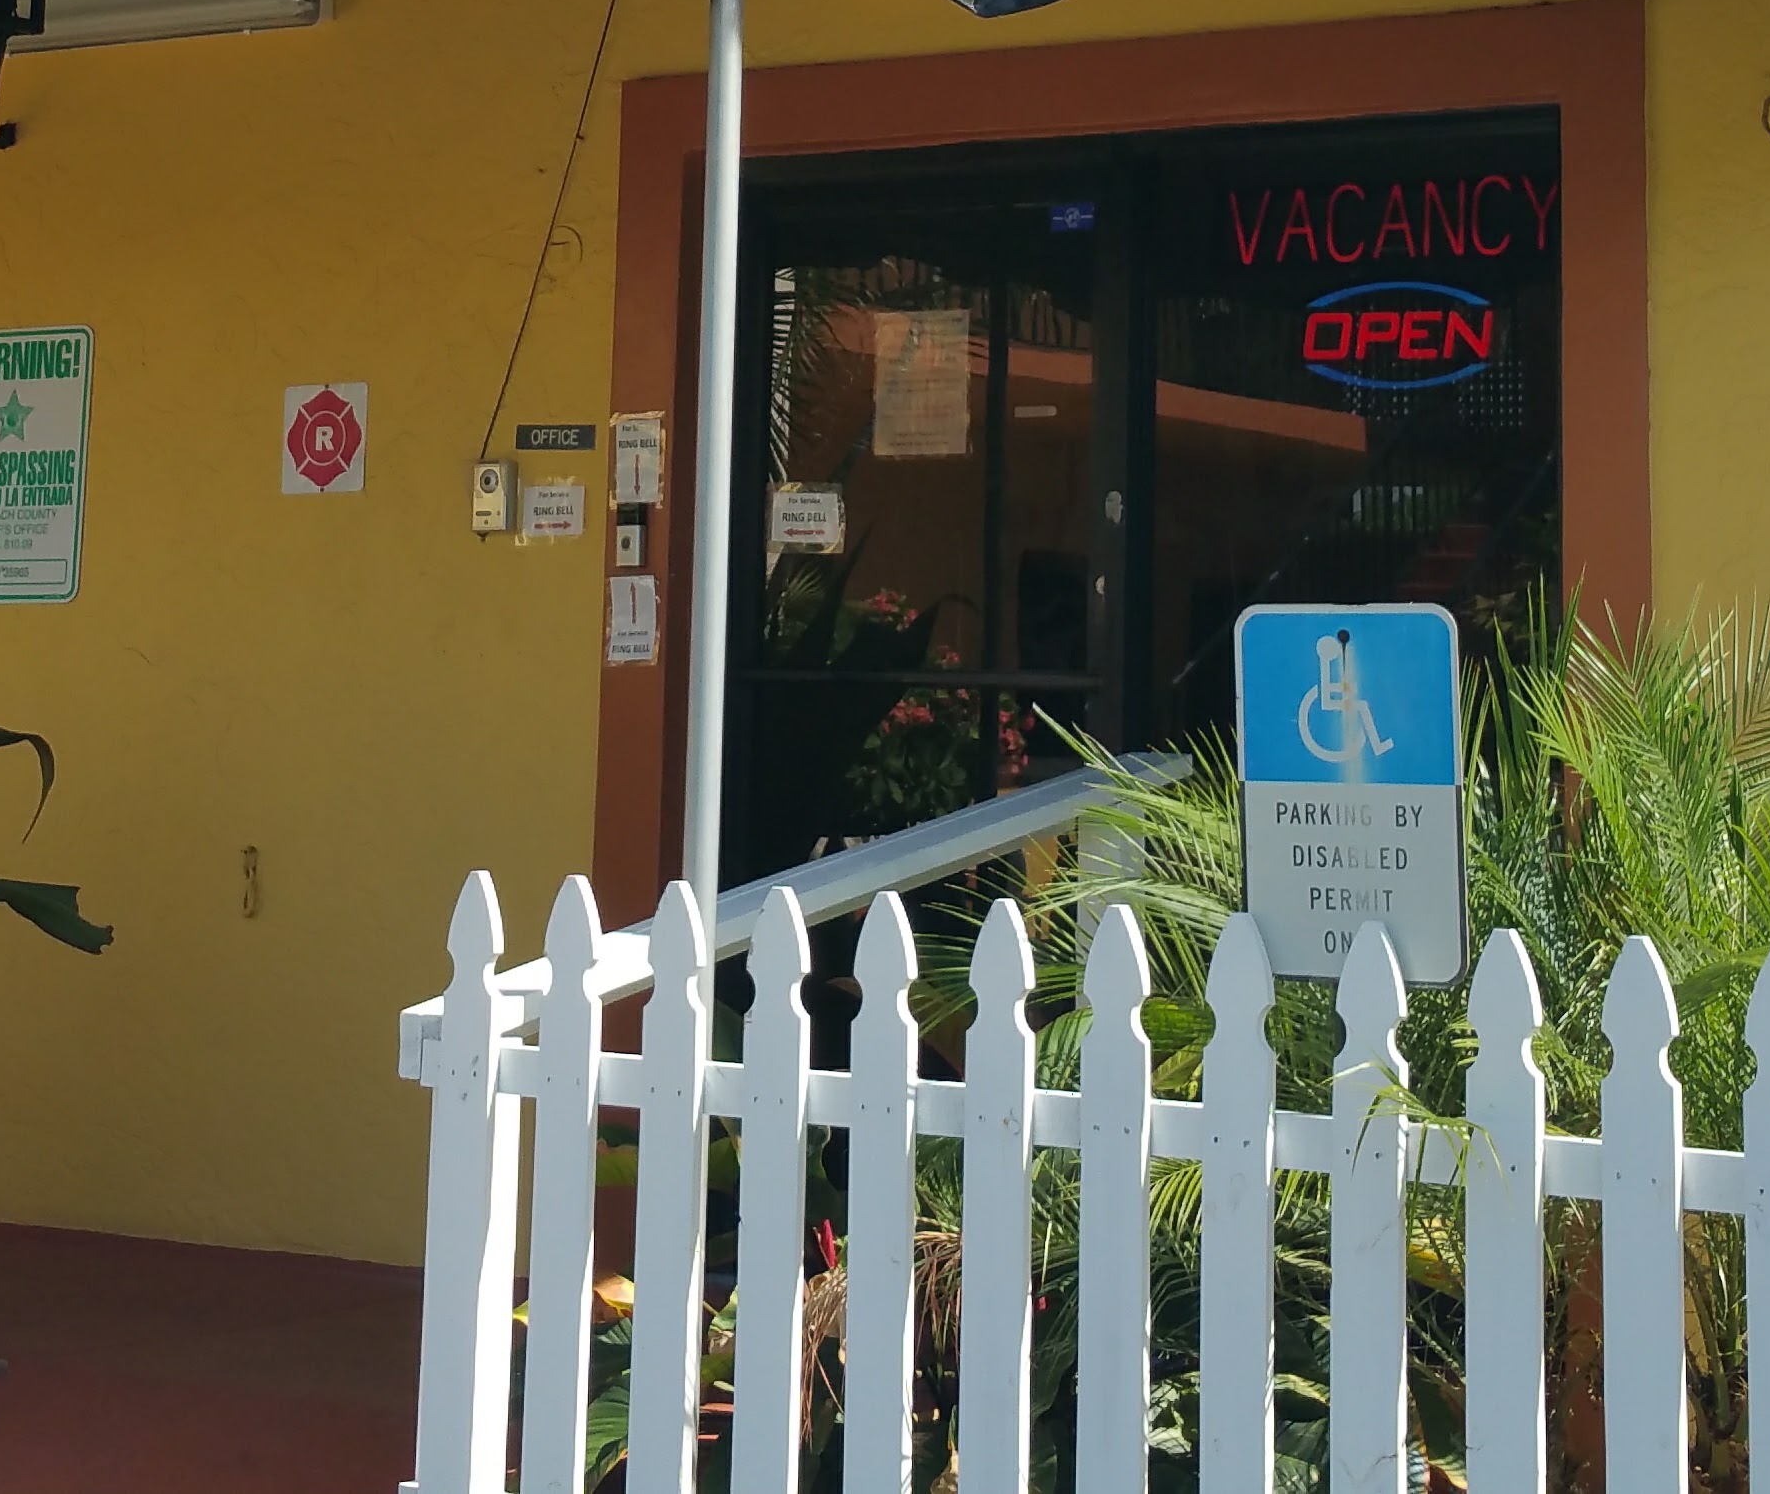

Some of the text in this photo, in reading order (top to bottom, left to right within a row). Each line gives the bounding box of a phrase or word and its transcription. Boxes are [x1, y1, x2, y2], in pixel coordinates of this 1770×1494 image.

[1229, 175, 1559, 265] VACANCY
[1302, 309, 1494, 362] OPEN
[315, 426, 334, 451] R
[530, 429, 580, 445] OFFICE
[618, 438, 658, 449] RING BELL
[5, 487, 18, 507] LA
[21, 485, 73, 507] ENTRADA
[17, 508, 57, 520] COUNTY
[533, 505, 575, 516] RING BELL
[782, 512, 827, 522] RING BELL
[13, 523, 49, 535] OFFICE
[612, 643, 651, 654] RING BELL
[1276, 801, 1424, 828] PARKING BY
[1292, 844, 1409, 871] DISABLED
[1309, 887, 1394, 912] PERMIT
[1324, 930, 1353, 954] ON
